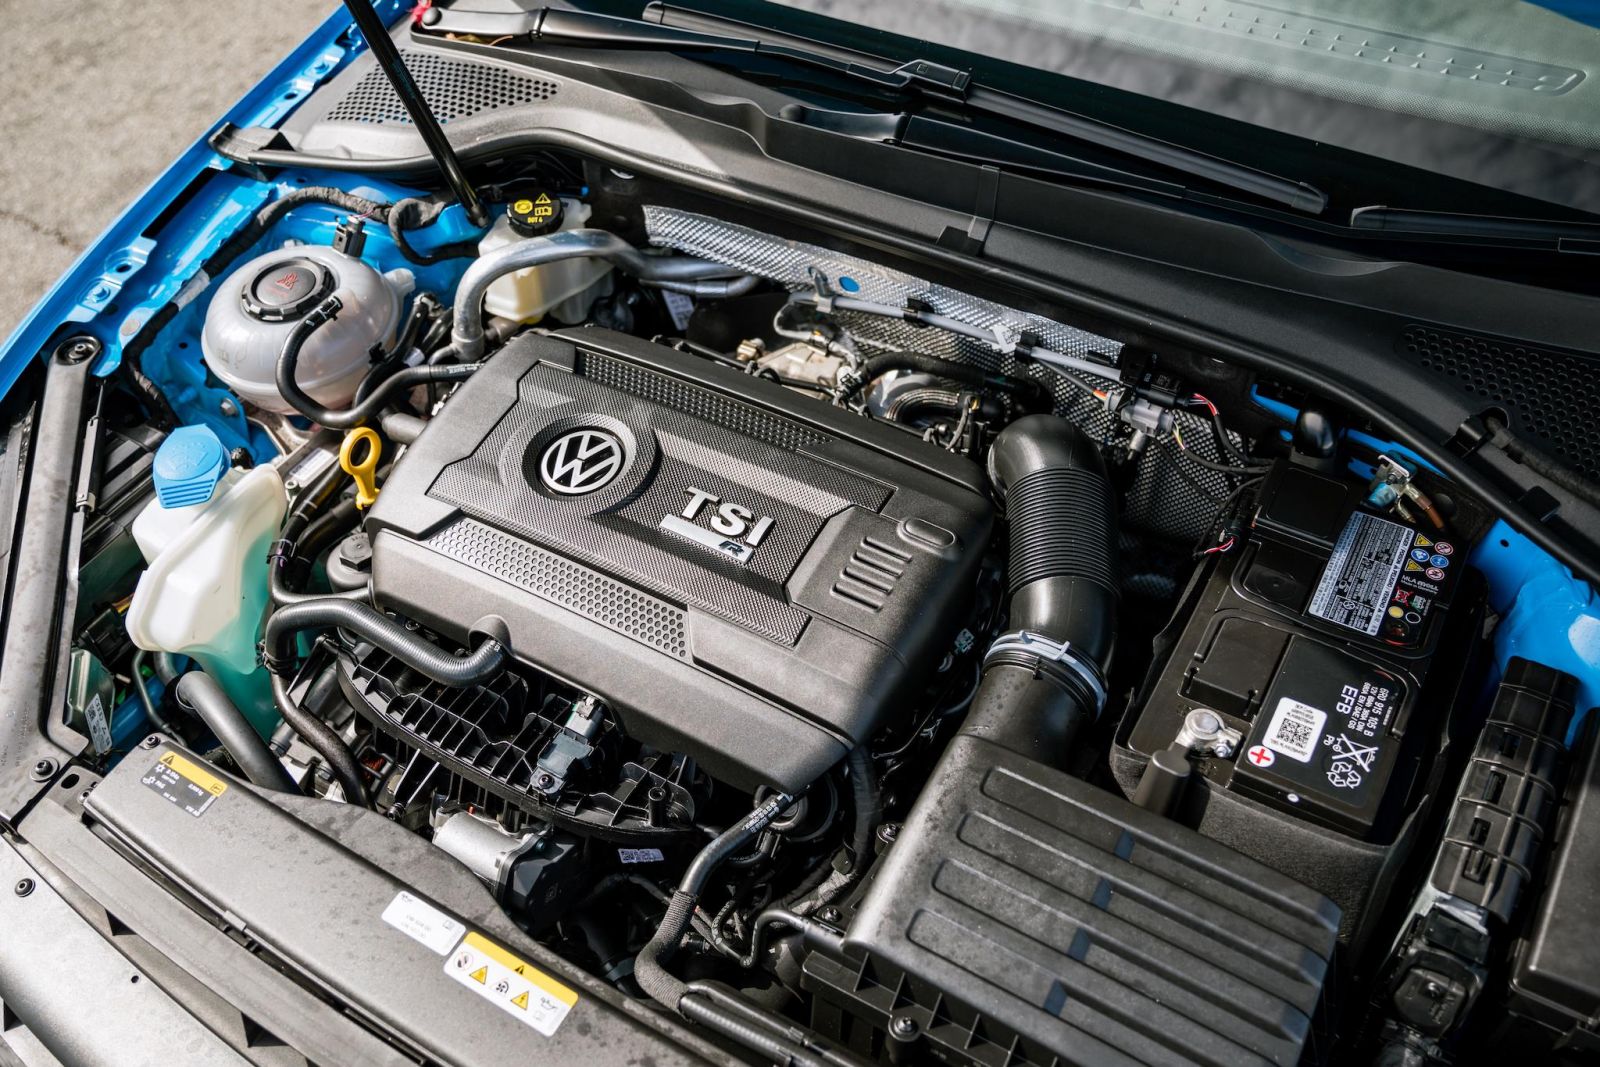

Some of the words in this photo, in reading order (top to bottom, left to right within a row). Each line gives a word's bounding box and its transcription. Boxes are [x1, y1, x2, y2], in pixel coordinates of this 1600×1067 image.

[680, 486, 774, 547] TSI
[718, 540, 745, 557] R
[1336, 685, 1358, 714] EFB
[1371, 701, 1384, 715] 915
[1366, 716, 1379, 729] 105
[1323, 733, 1336, 747] Pb
[1363, 729, 1374, 737] B
